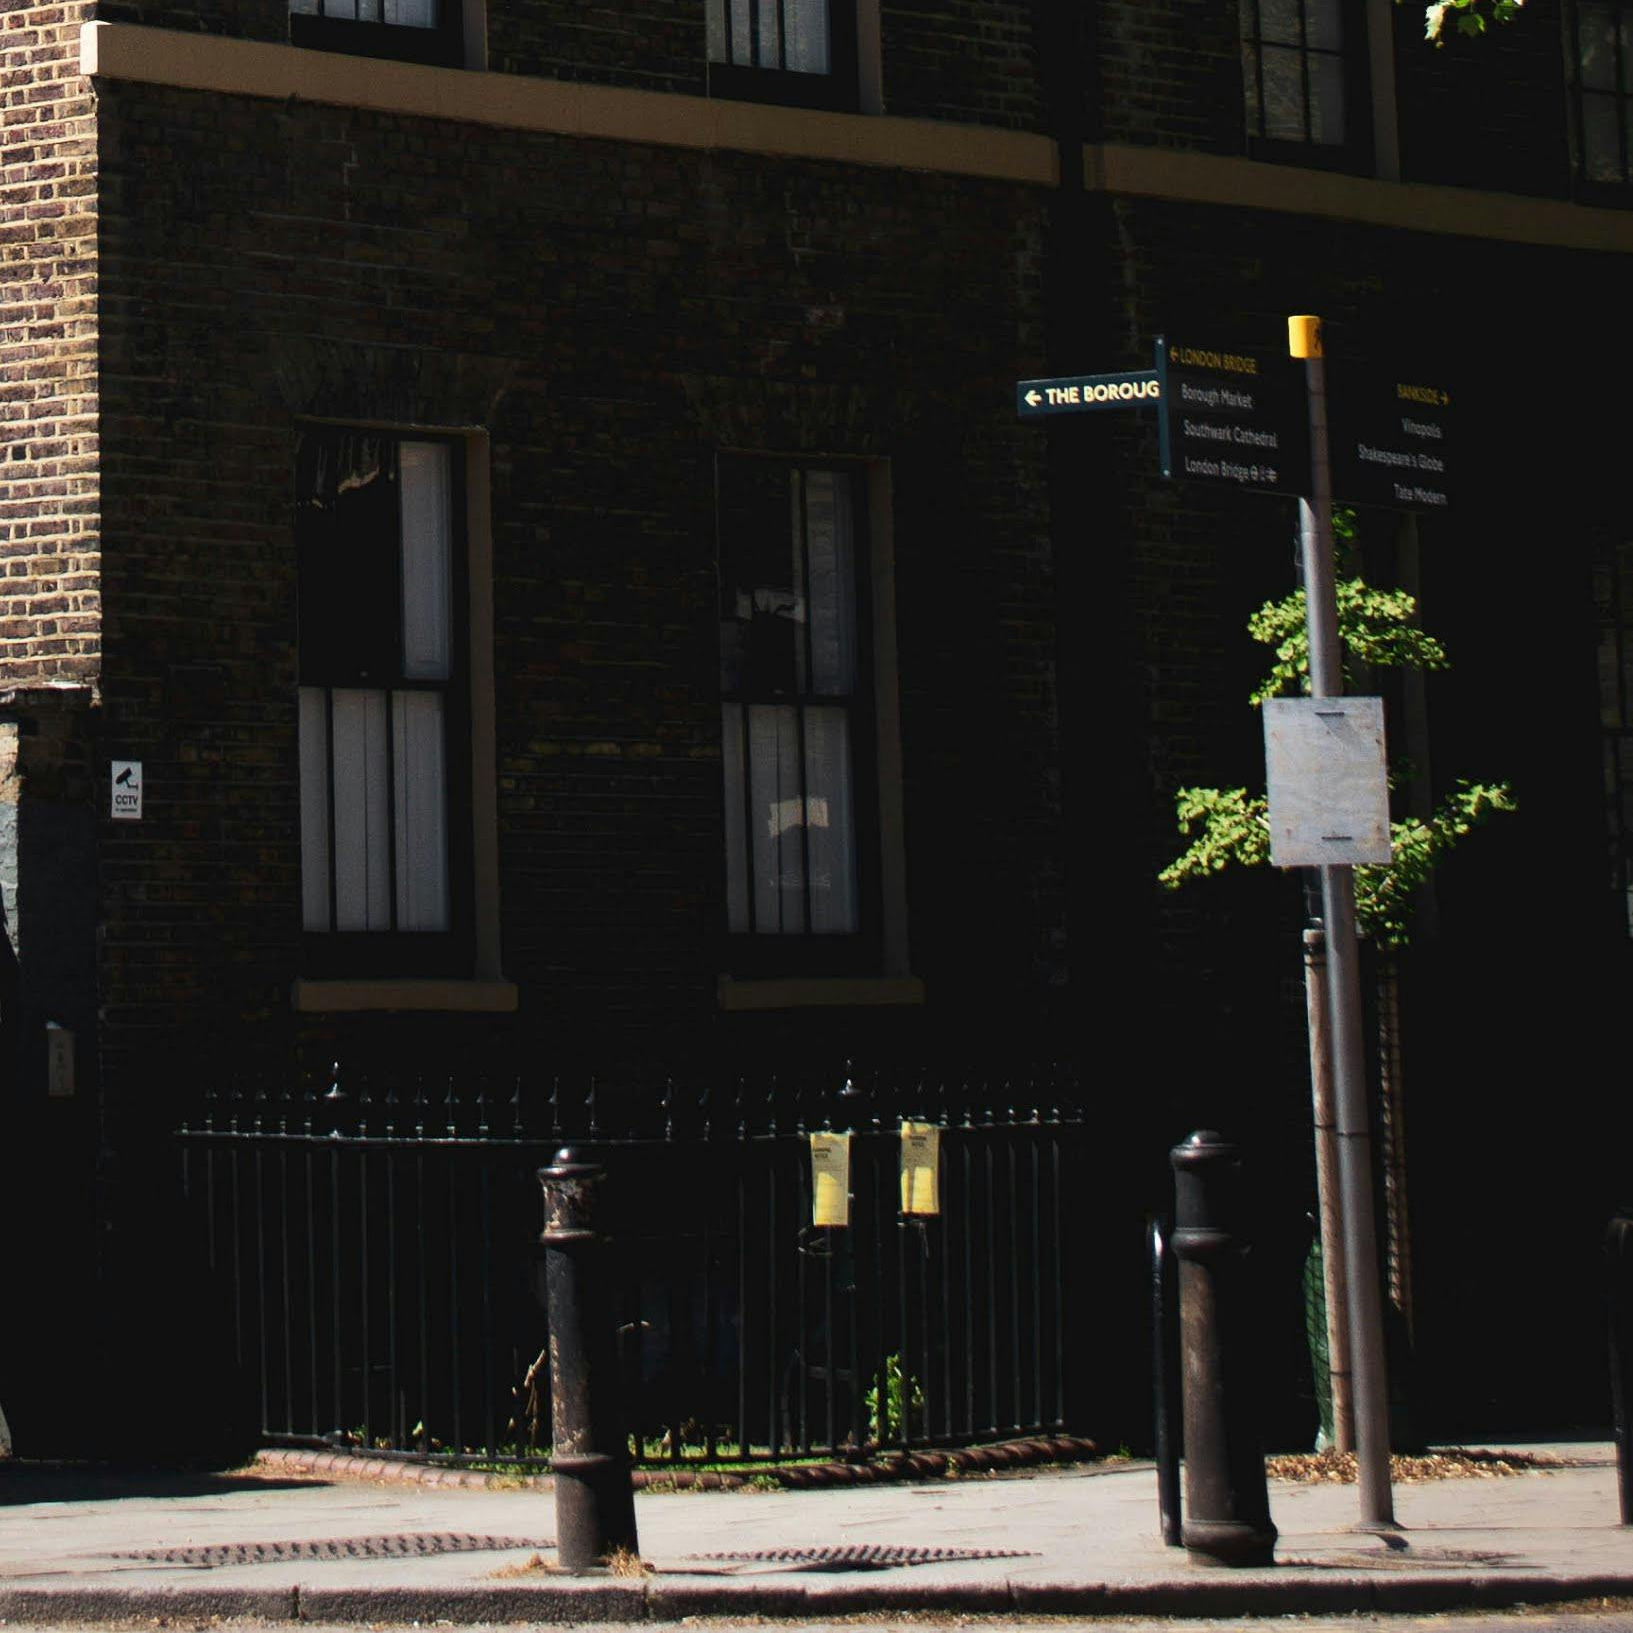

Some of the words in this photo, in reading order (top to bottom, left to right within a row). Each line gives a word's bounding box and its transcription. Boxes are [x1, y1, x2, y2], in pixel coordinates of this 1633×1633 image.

[1180, 347, 1222, 368] LONDON
[1223, 352, 1257, 375] BRIDGE
[1045, 386, 1081, 406] THE
[1083, 380, 1160, 403] BOROUG
[1181, 383, 1219, 406] Borough
[1221, 388, 1253, 409] Market
[1398, 383, 1439, 406] BANKSIDE
[1183, 418, 1232, 442] Southwark
[1234, 426, 1278, 449] Cathedral
[1401, 417, 1443, 439] Vinopolis
[1184, 455, 1219, 476] London
[1221, 460, 1249, 483] Bridge
[1418, 453, 1444, 473] Globe
[1393, 482, 1413, 500] Tate
[1414, 487, 1449, 506] Modern
[115, 795, 138, 805] CCTV
